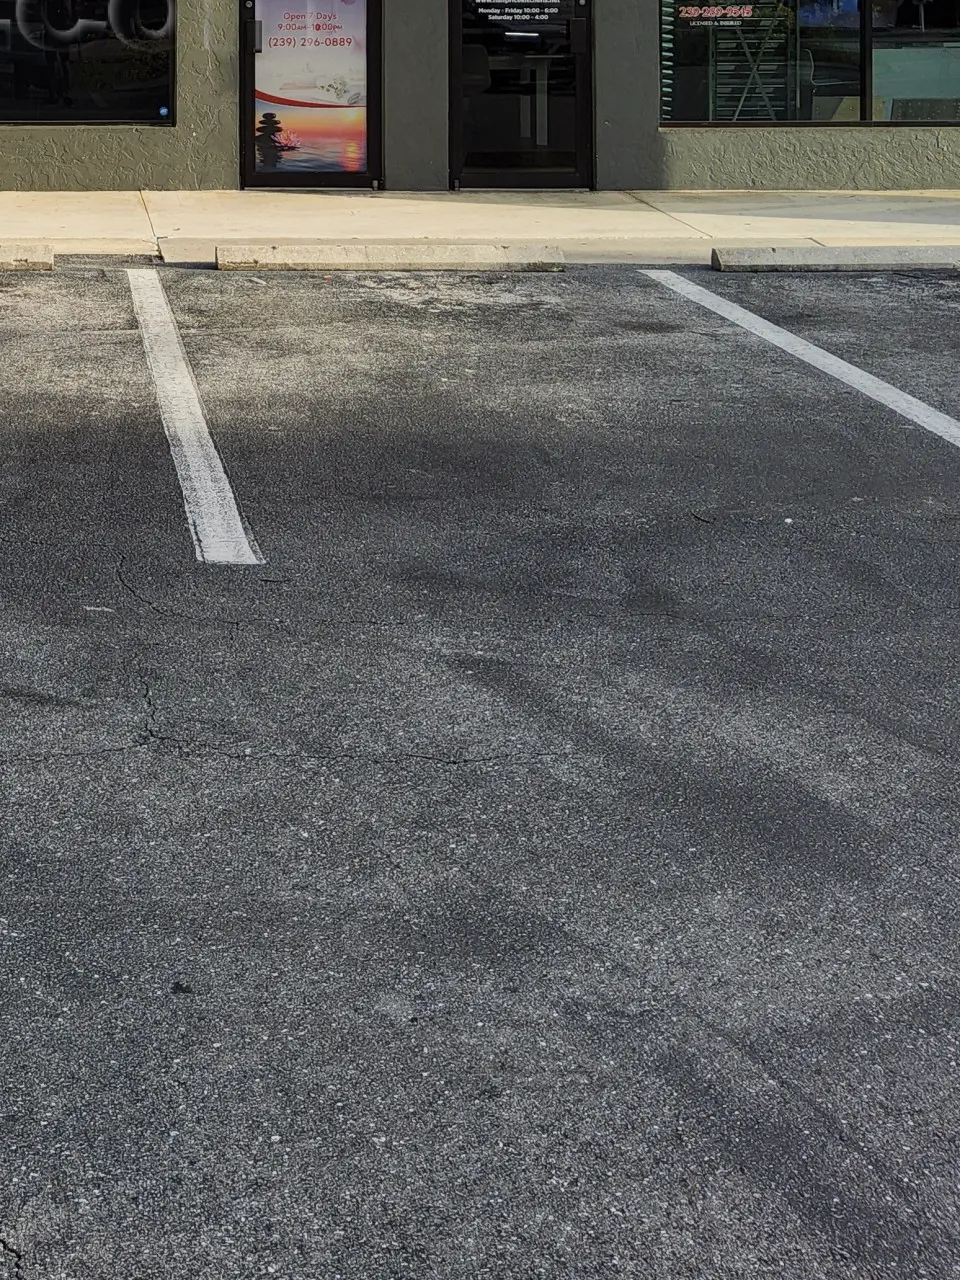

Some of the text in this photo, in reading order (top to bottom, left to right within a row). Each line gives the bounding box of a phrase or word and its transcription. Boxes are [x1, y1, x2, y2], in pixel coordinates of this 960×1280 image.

[283, 12, 306, 22] Open
[316, 12, 337, 22] Days
[268, 37, 353, 48] (239) 296-0889
